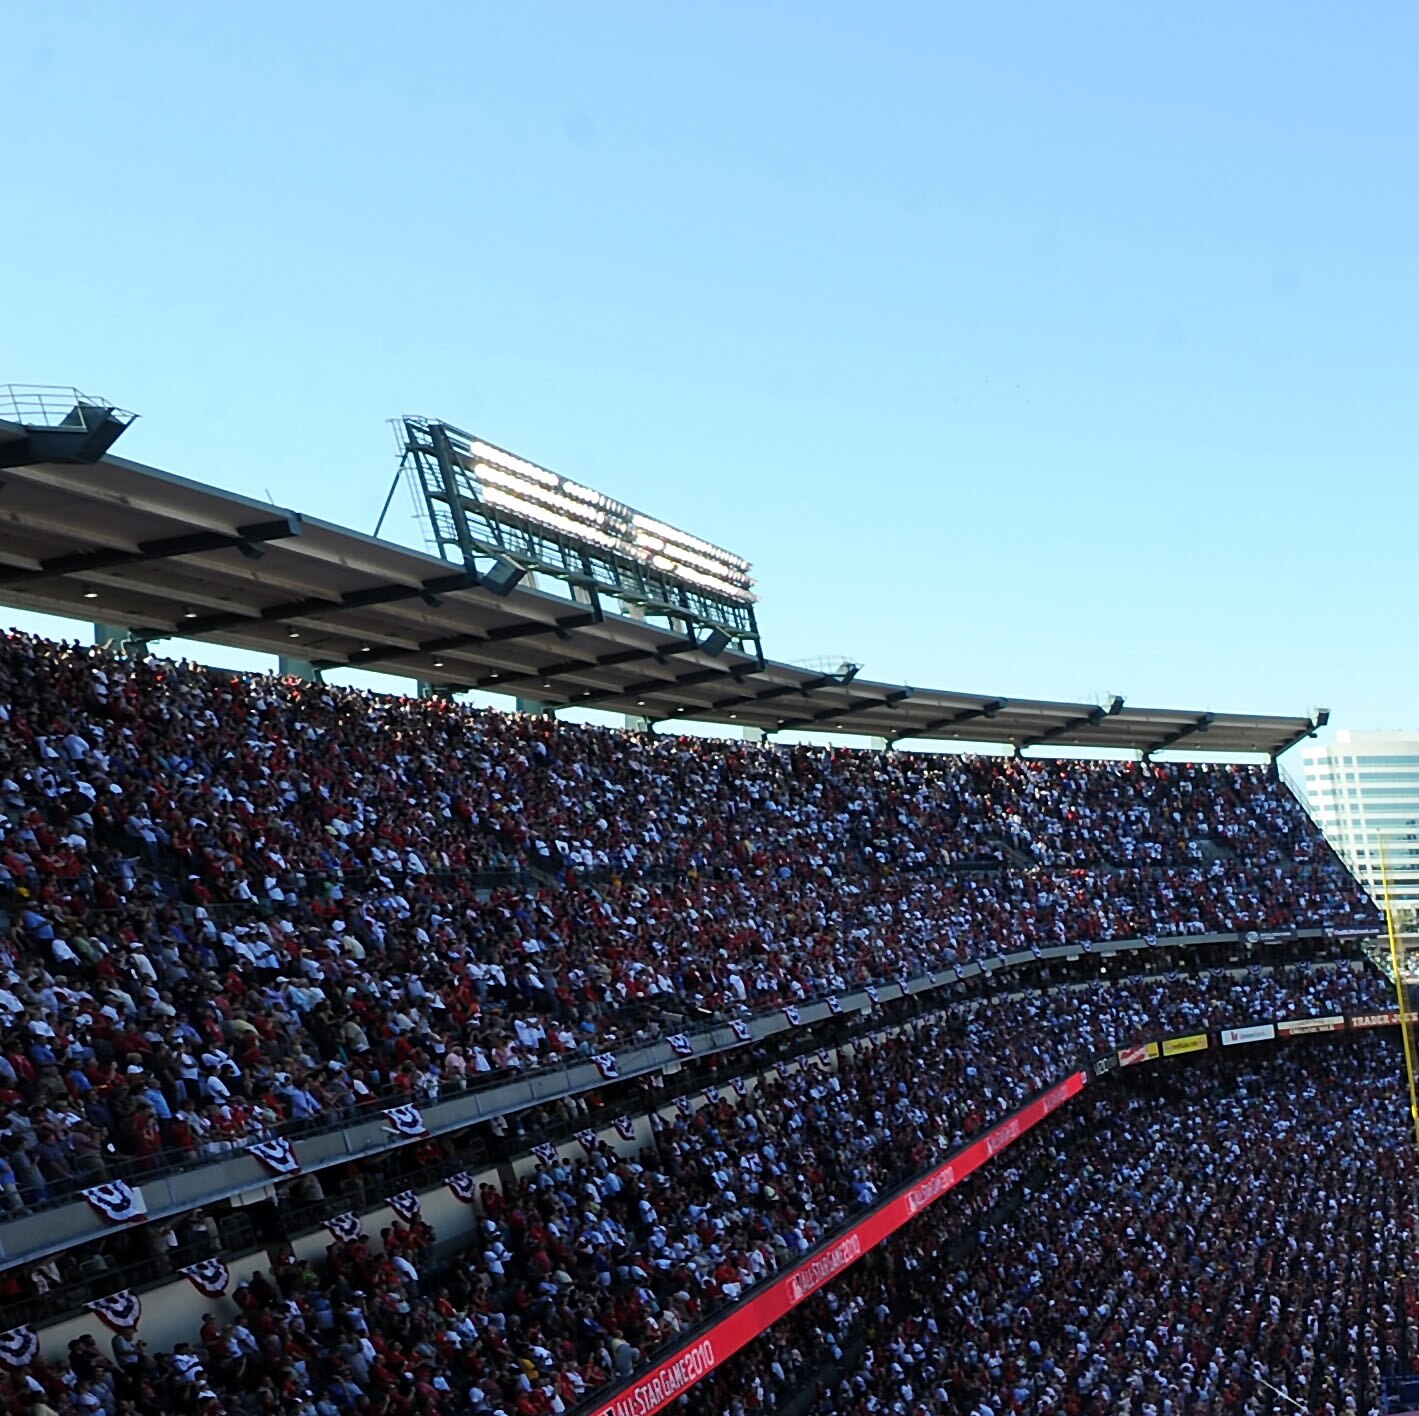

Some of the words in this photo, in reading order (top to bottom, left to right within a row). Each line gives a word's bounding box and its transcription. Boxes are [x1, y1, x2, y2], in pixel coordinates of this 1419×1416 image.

[1352, 1014, 1389, 1026] TRADER
[659, 1360, 690, 1397] GAME
[684, 1339, 715, 1382] 2010
